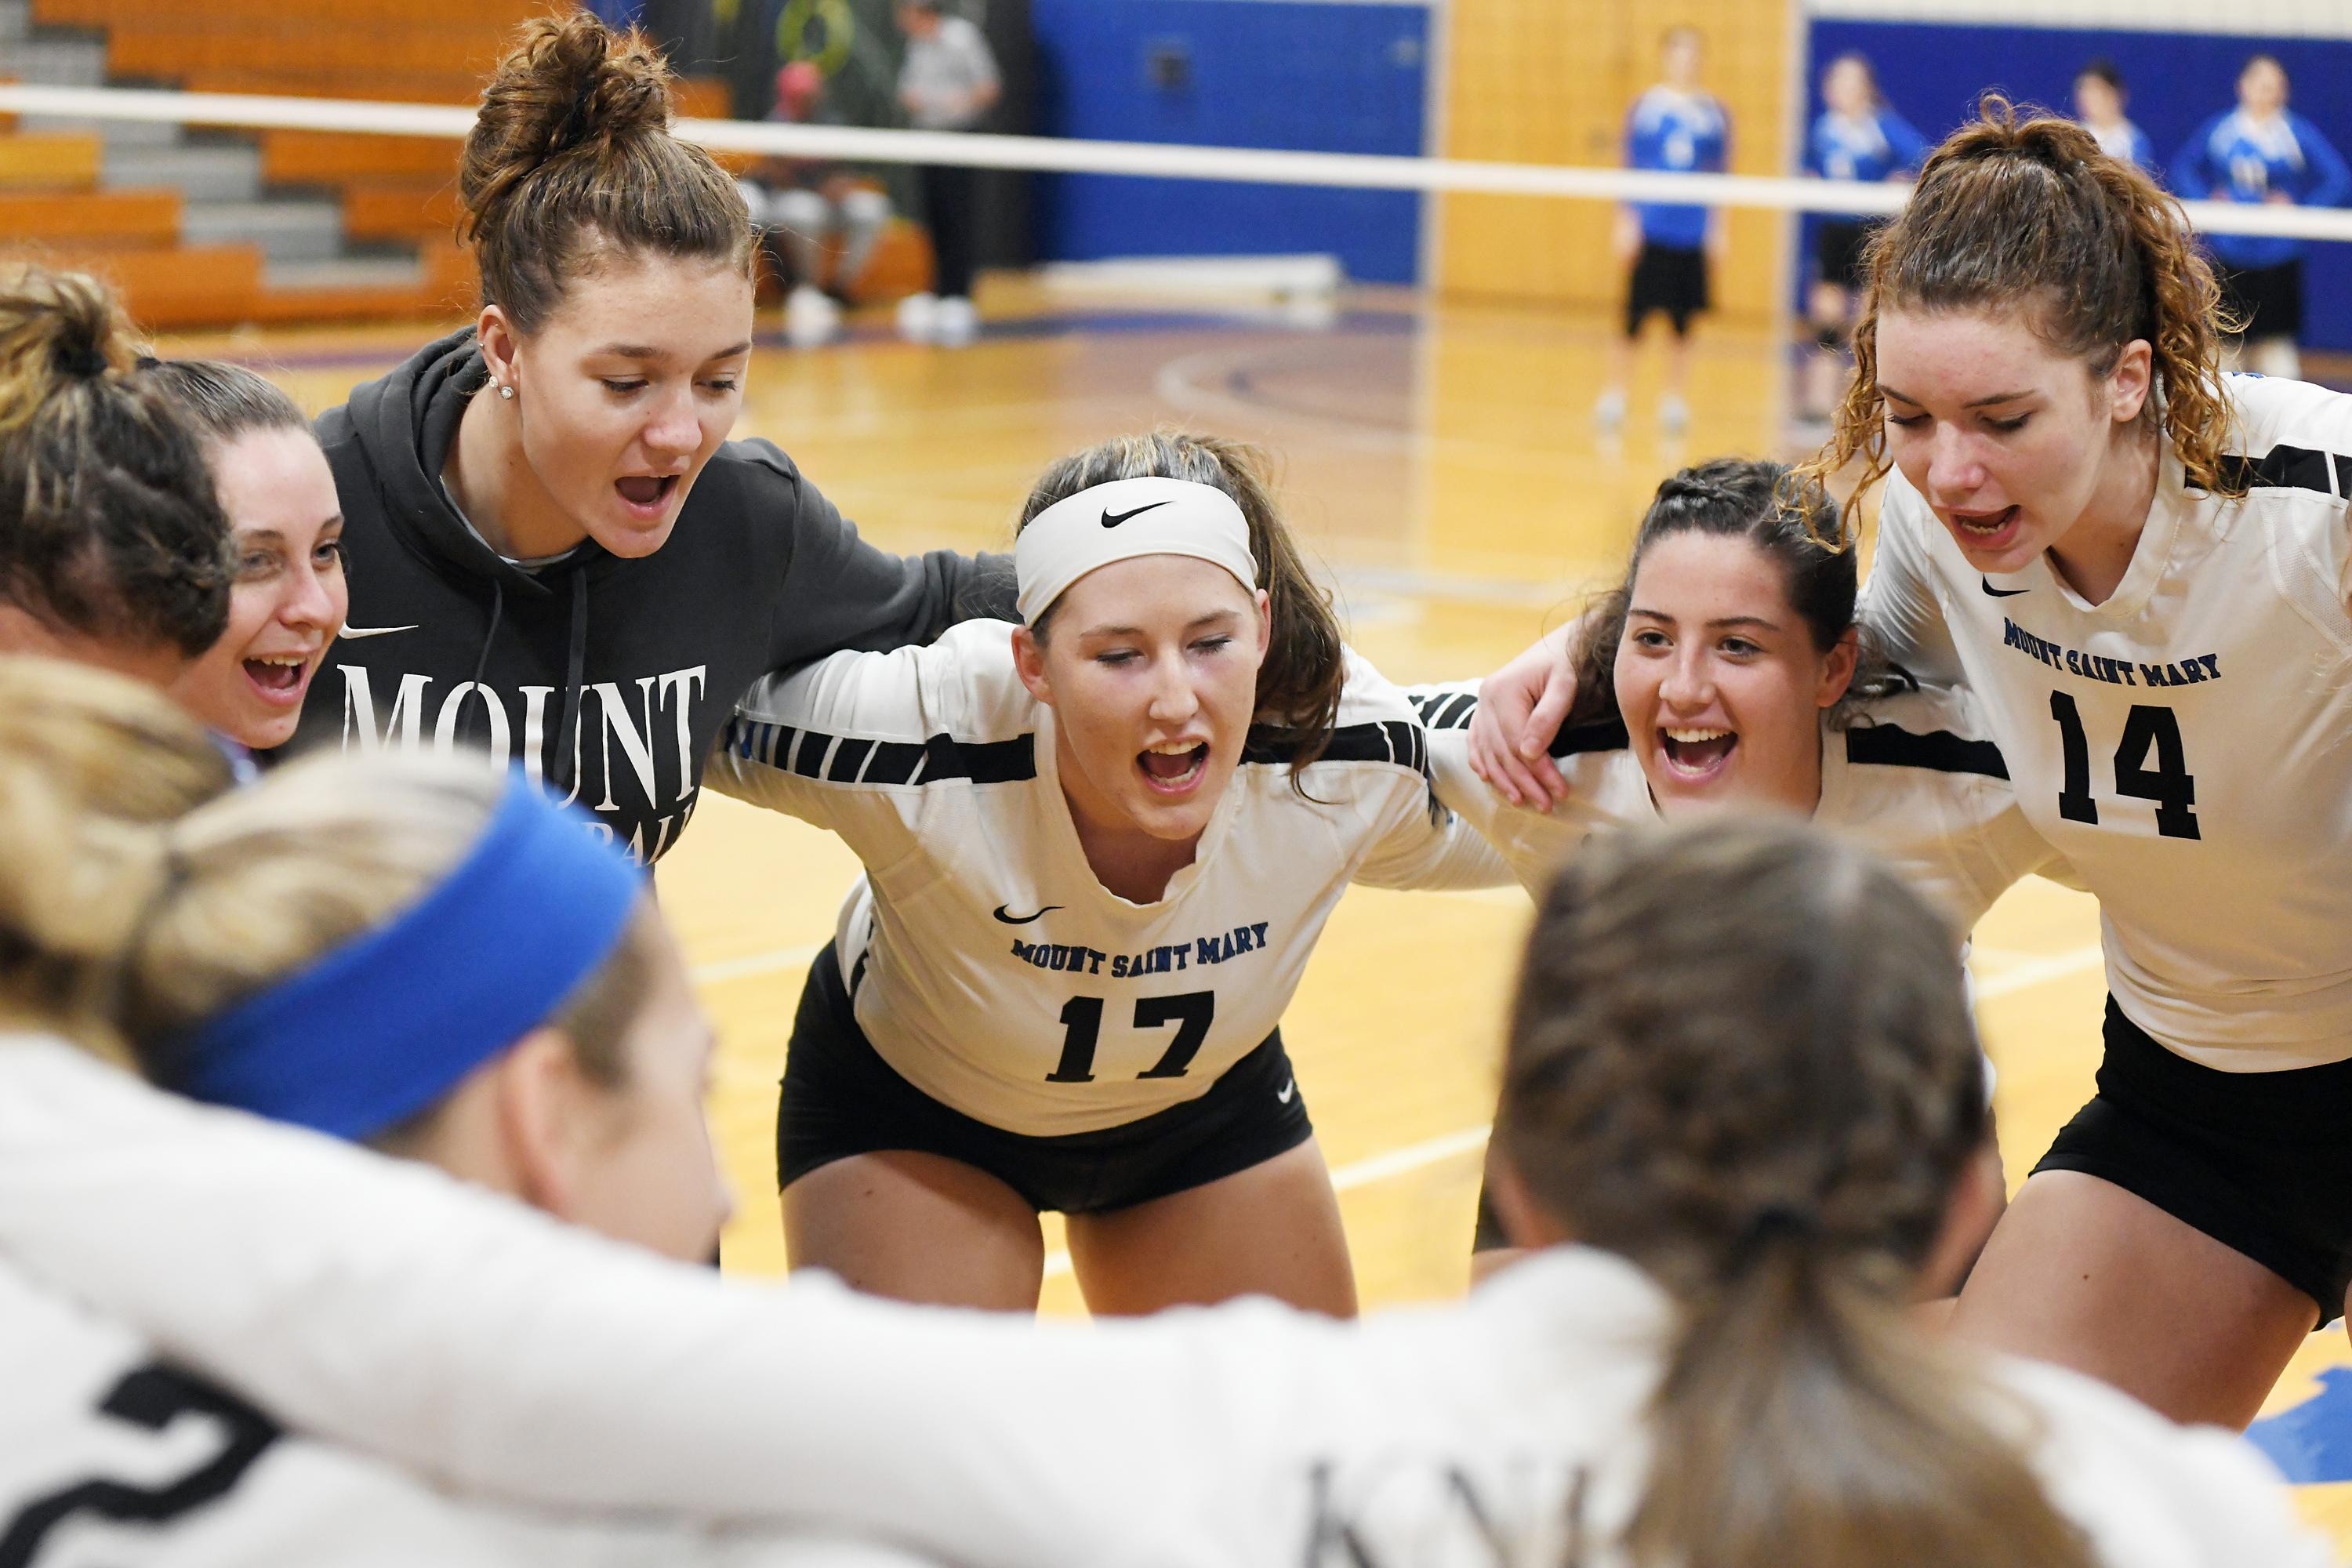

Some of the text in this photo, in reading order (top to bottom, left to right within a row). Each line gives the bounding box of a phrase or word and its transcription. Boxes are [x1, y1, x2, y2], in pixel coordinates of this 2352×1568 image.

[2003, 616, 2222, 687] MOUNT SAINT MARY
[336, 664, 706, 810] MOUNT
[2049, 689, 2201, 840] 14
[1011, 921, 1269, 978] MOUNT SAINT MARY
[1044, 989, 1215, 1083] 17
